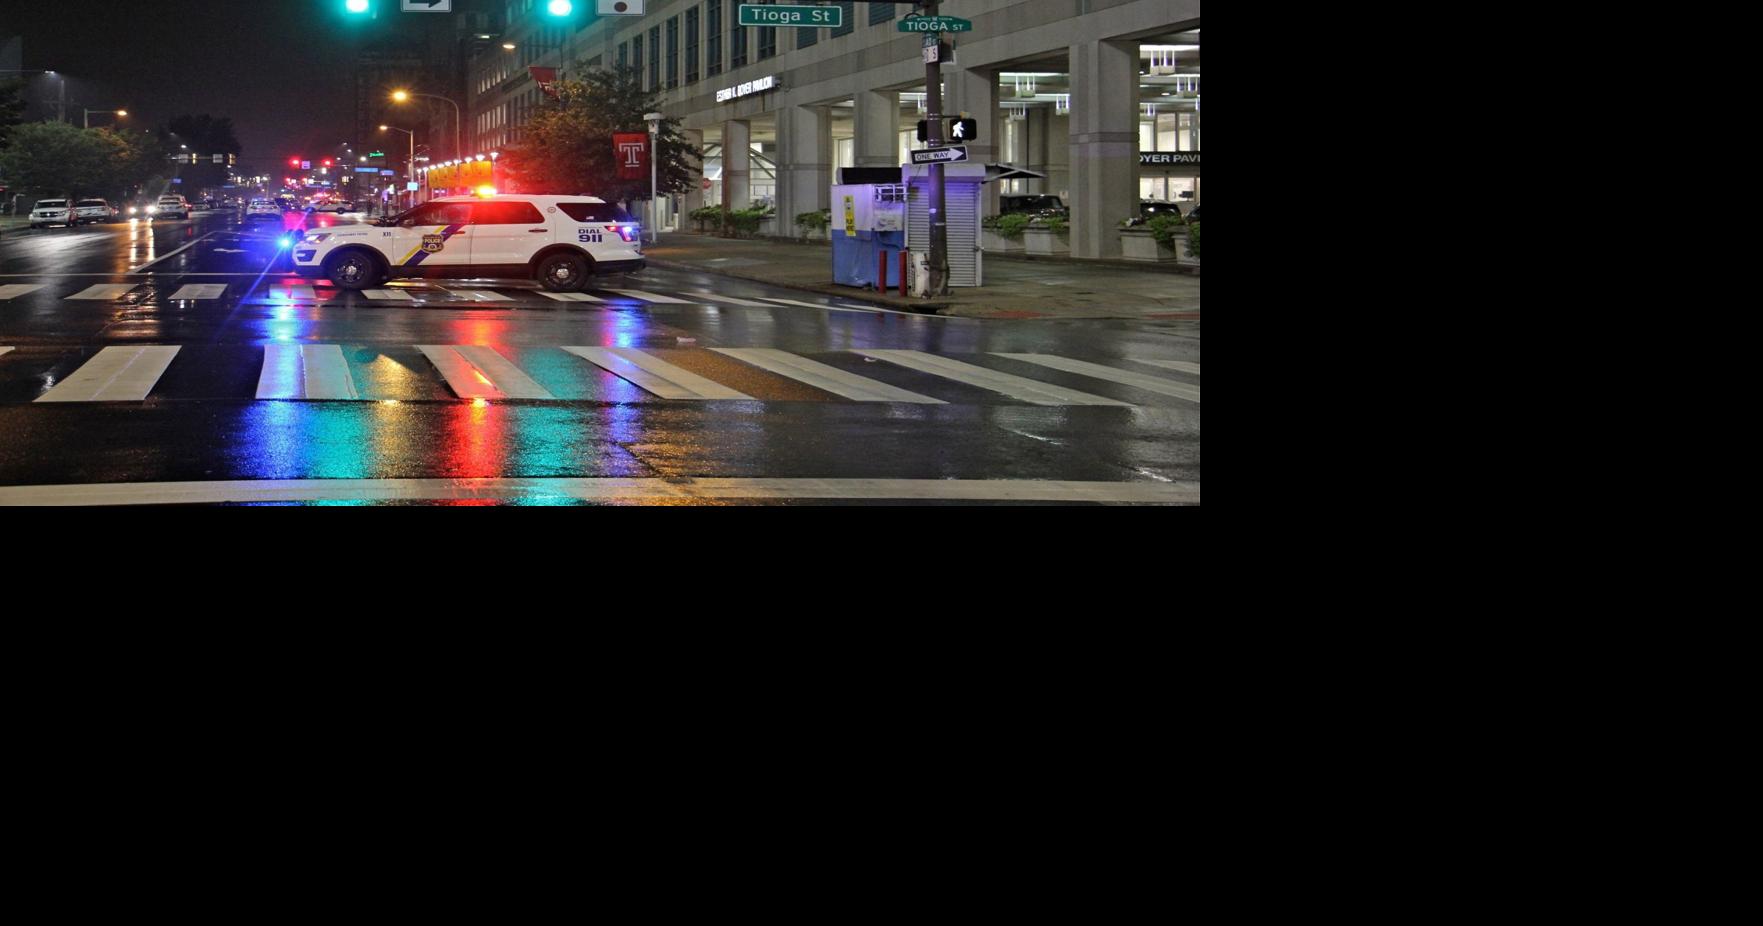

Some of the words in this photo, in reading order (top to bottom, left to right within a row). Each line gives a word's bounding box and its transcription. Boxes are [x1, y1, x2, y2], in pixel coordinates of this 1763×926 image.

[751, 8, 801, 24] Tioga
[811, 9, 830, 22] St
[906, 21, 949, 31] TIOGA
[952, 23, 964, 31] ST
[618, 142, 645, 168] T
[933, 151, 950, 159] WAY
[578, 234, 603, 243] 911
